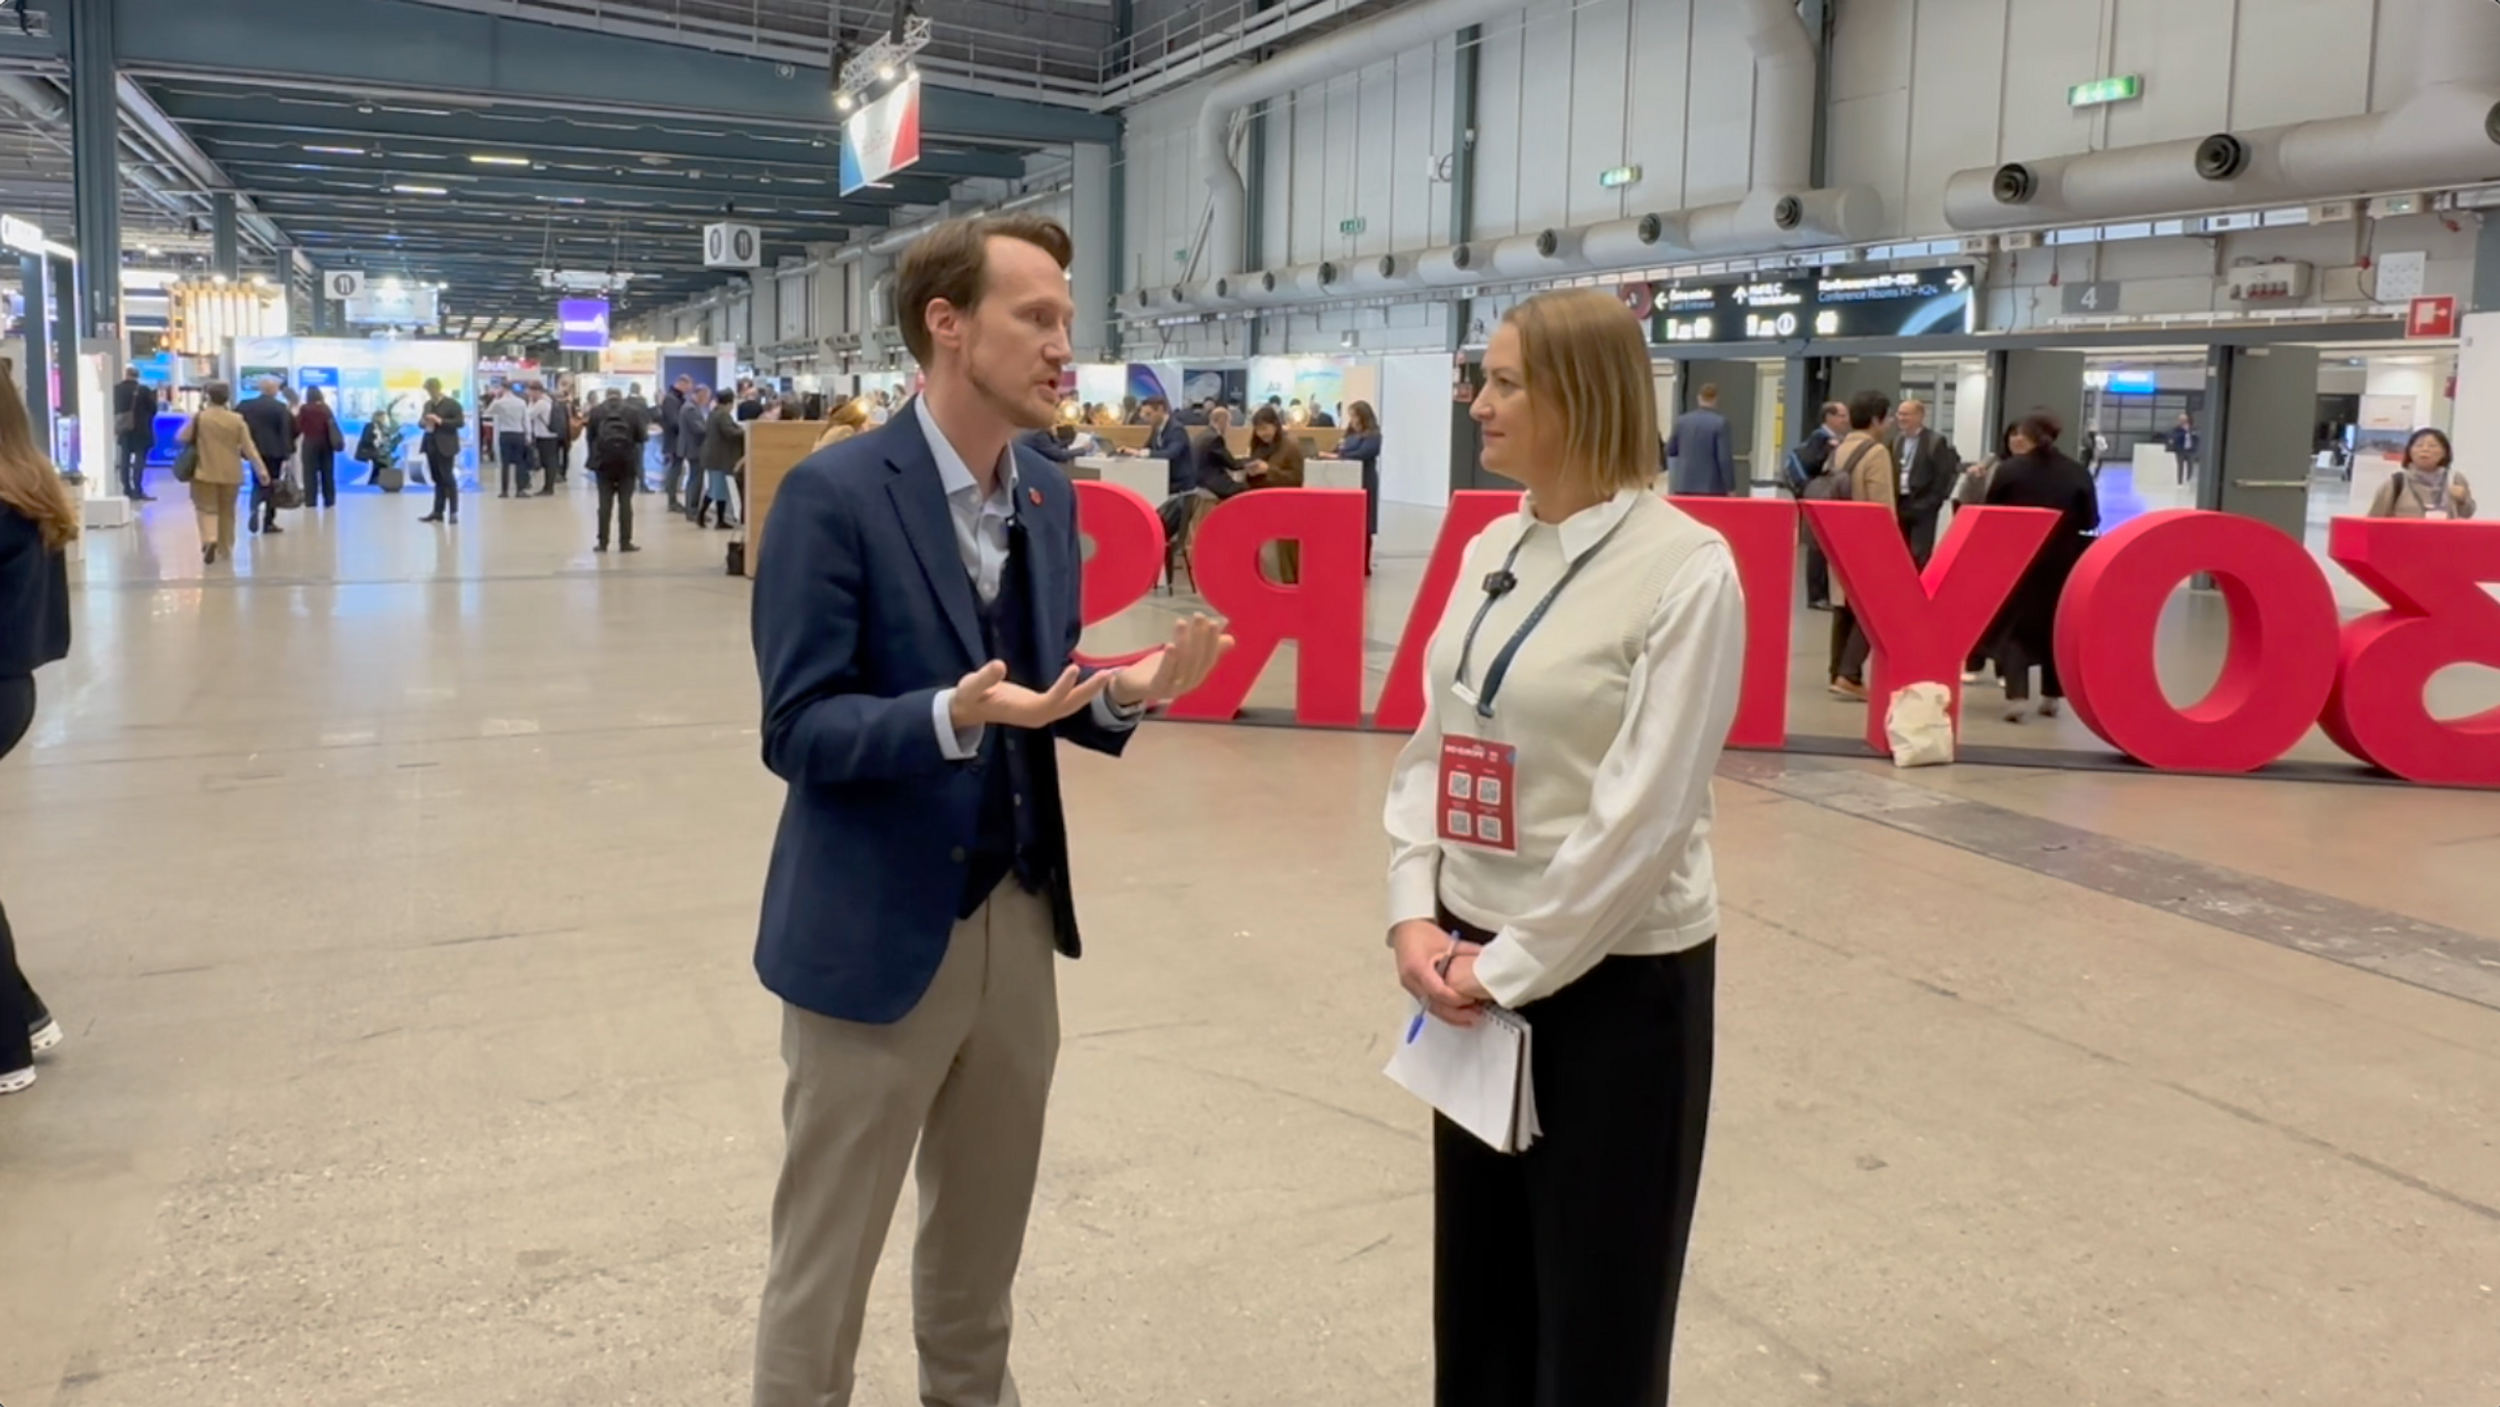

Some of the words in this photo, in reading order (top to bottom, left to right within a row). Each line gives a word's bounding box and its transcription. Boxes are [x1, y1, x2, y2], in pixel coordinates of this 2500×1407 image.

[1818, 289, 1866, 302] Conference
[1868, 287, 1898, 299] Rooms
[2080, 286, 2098, 309] 4
